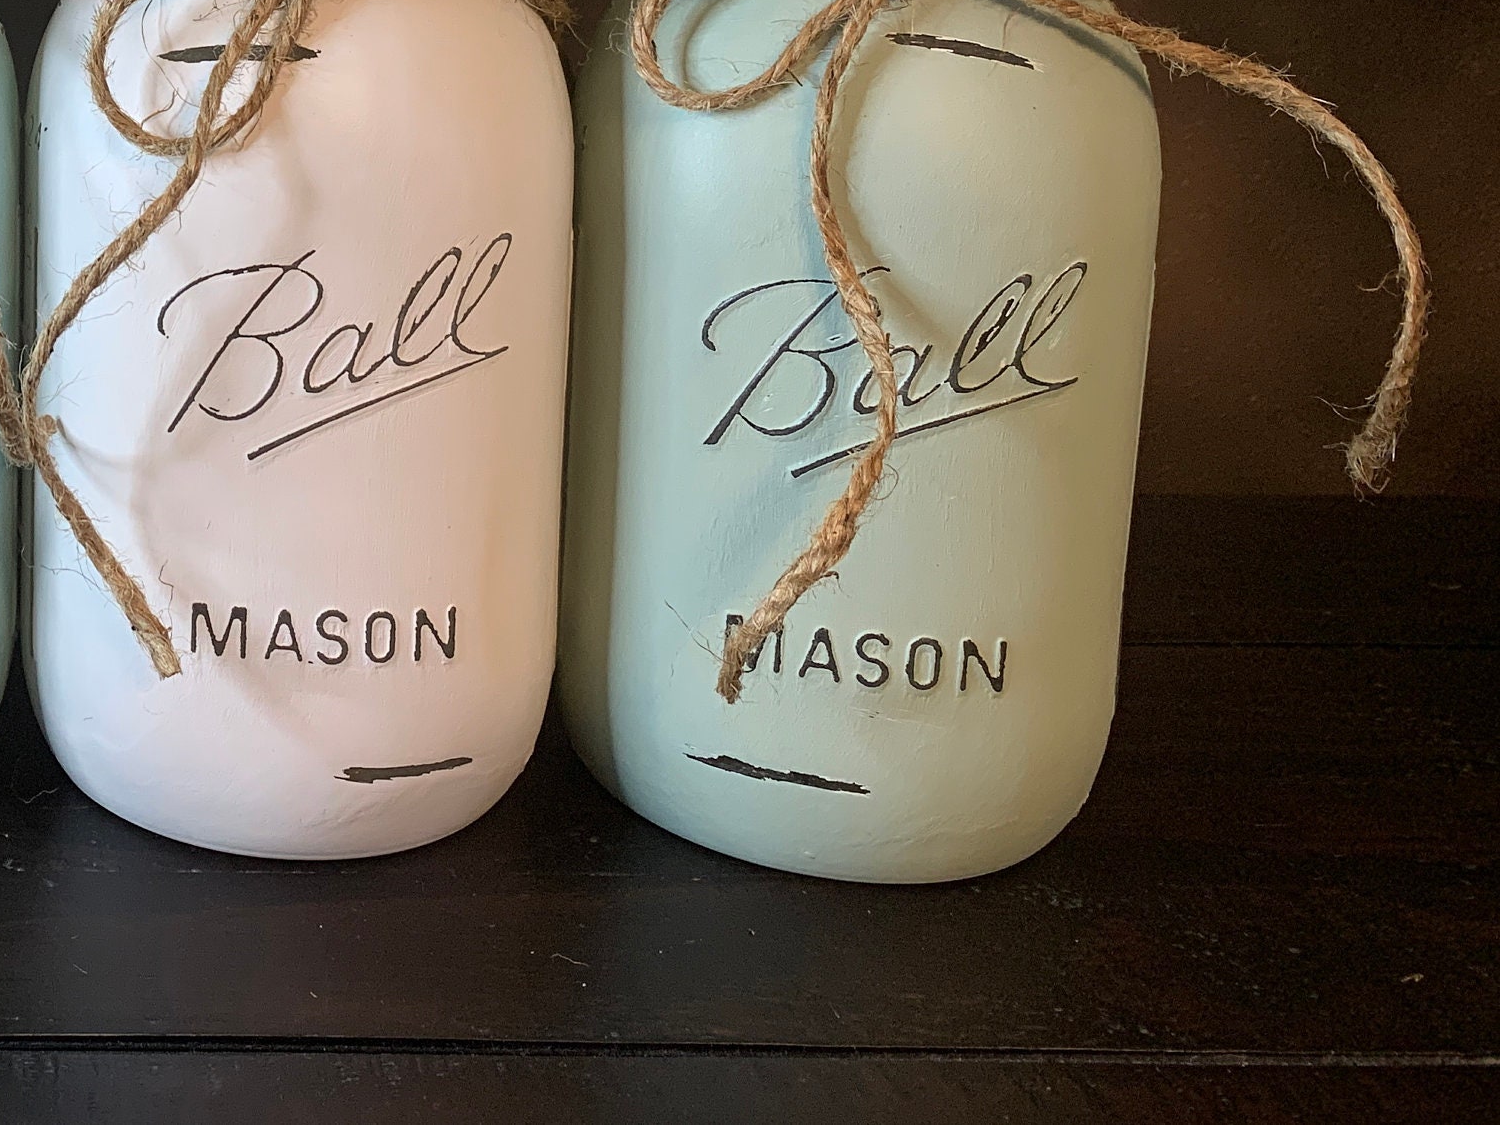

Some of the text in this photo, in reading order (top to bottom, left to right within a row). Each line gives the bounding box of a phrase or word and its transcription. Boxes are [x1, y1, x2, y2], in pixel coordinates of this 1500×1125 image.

[157, 233, 512, 460] Ball
[701, 261, 1087, 478] Ball
[190, 603, 457, 666] MASON
